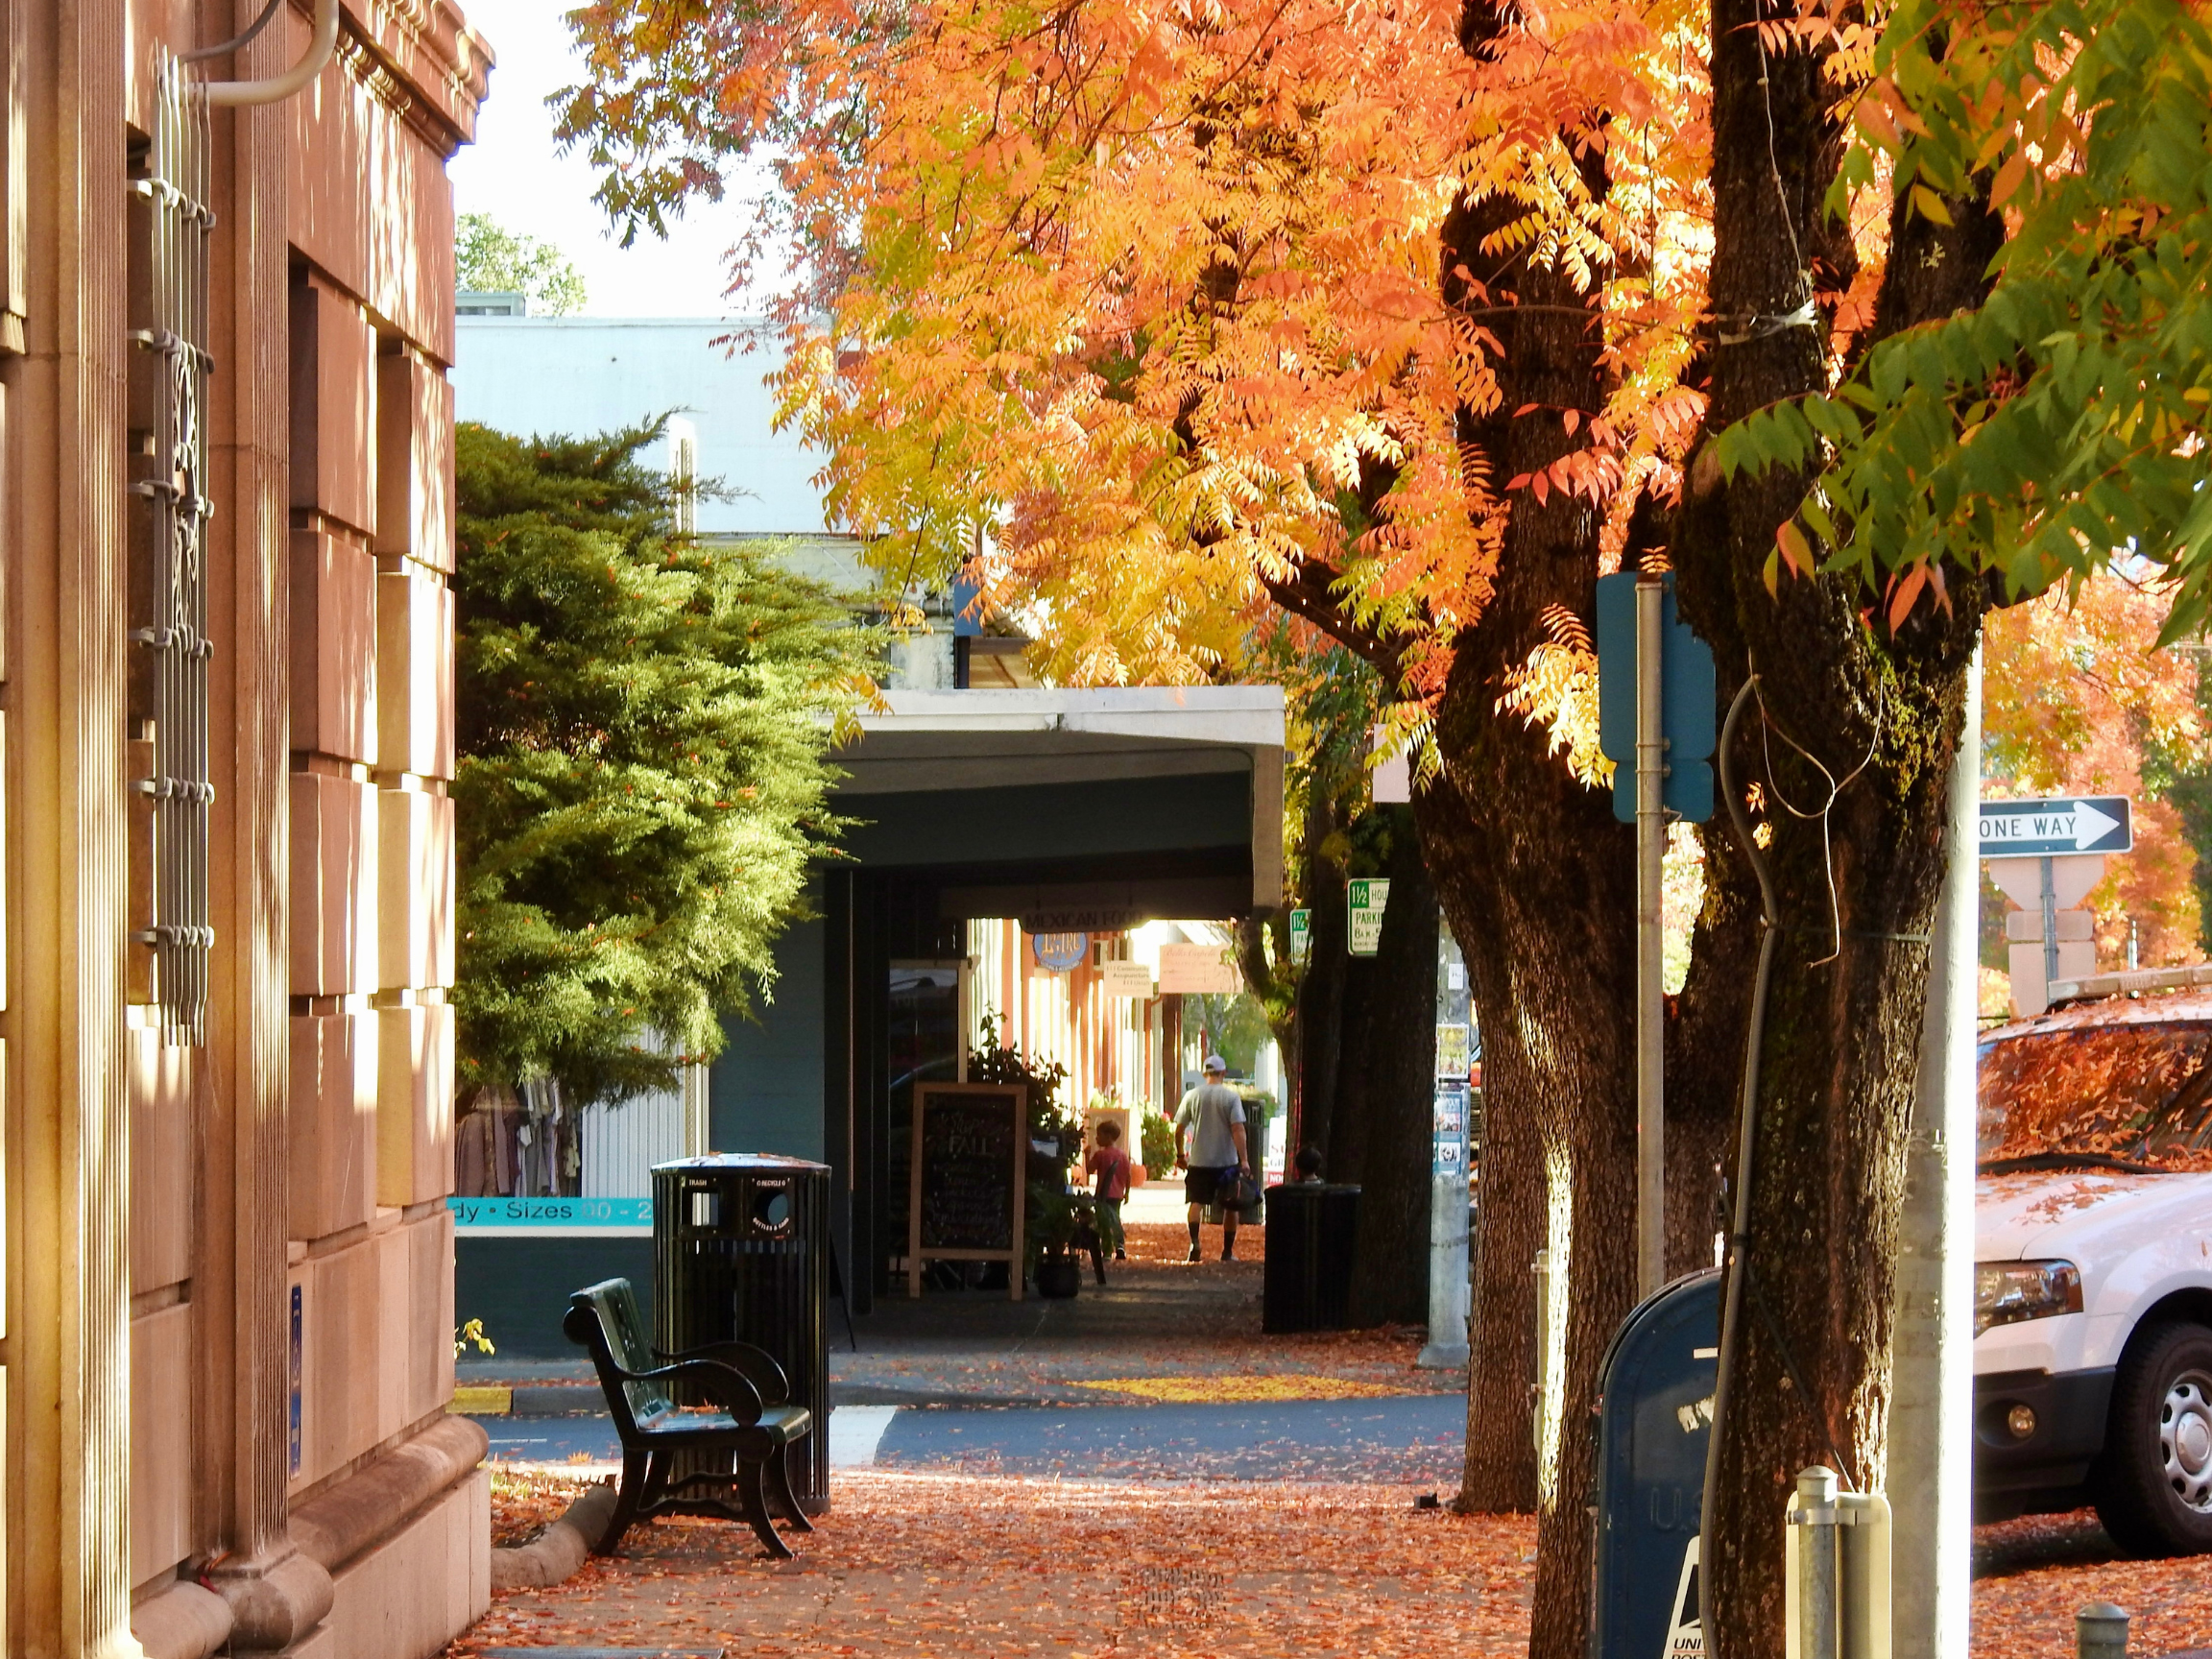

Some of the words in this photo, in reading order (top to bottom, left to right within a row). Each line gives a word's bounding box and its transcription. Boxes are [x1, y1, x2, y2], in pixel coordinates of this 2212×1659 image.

[1980, 818, 2022, 837] ONE
[2033, 816, 2078, 835] WAY
[1371, 889, 1388, 901] HOU
[1025, 912, 1097, 928] MEXICAN
[1102, 910, 1142, 926] FOOD
[1356, 911, 1382, 925] PARKI
[688, 1178, 708, 1187] TRASH
[760, 1179, 782, 1188] RECYCLE
[453, 1201, 480, 1223] dy
[506, 1201, 573, 1219] Sizes
[582, 1202, 613, 1220] 00
[637, 1202, 653, 1219] 2
[752, 1216, 773, 1232] BOTTLES
[1674, 1638, 1702, 1649] UNI
